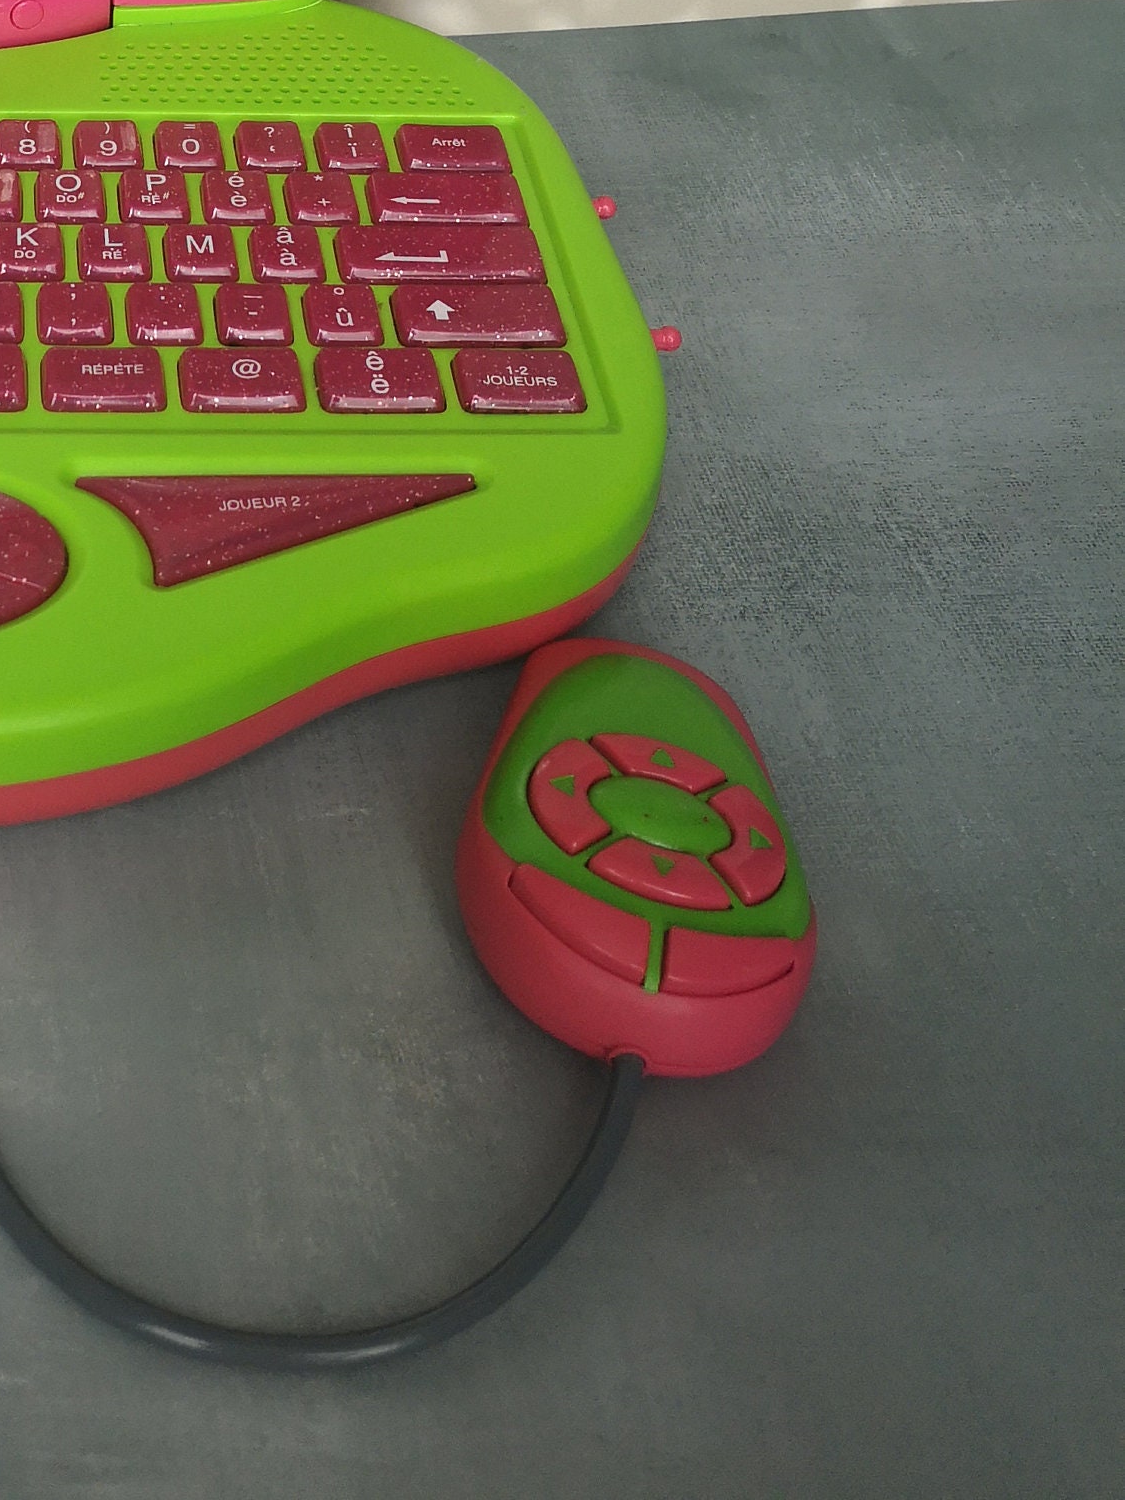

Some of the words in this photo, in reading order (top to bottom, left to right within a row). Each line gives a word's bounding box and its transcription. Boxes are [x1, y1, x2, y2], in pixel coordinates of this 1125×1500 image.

[432, 137, 466, 147] Arrêt
[145, 174, 166, 191] P
[16, 228, 39, 246] K
[186, 235, 215, 254] M
[82, 363, 144, 376] RÉPÈTE
[505, 366, 529, 375] 1-2
[482, 375, 558, 387] JOUEURS
[219, 496, 287, 511] JOUEUR
[291, 496, 301, 507] 2
